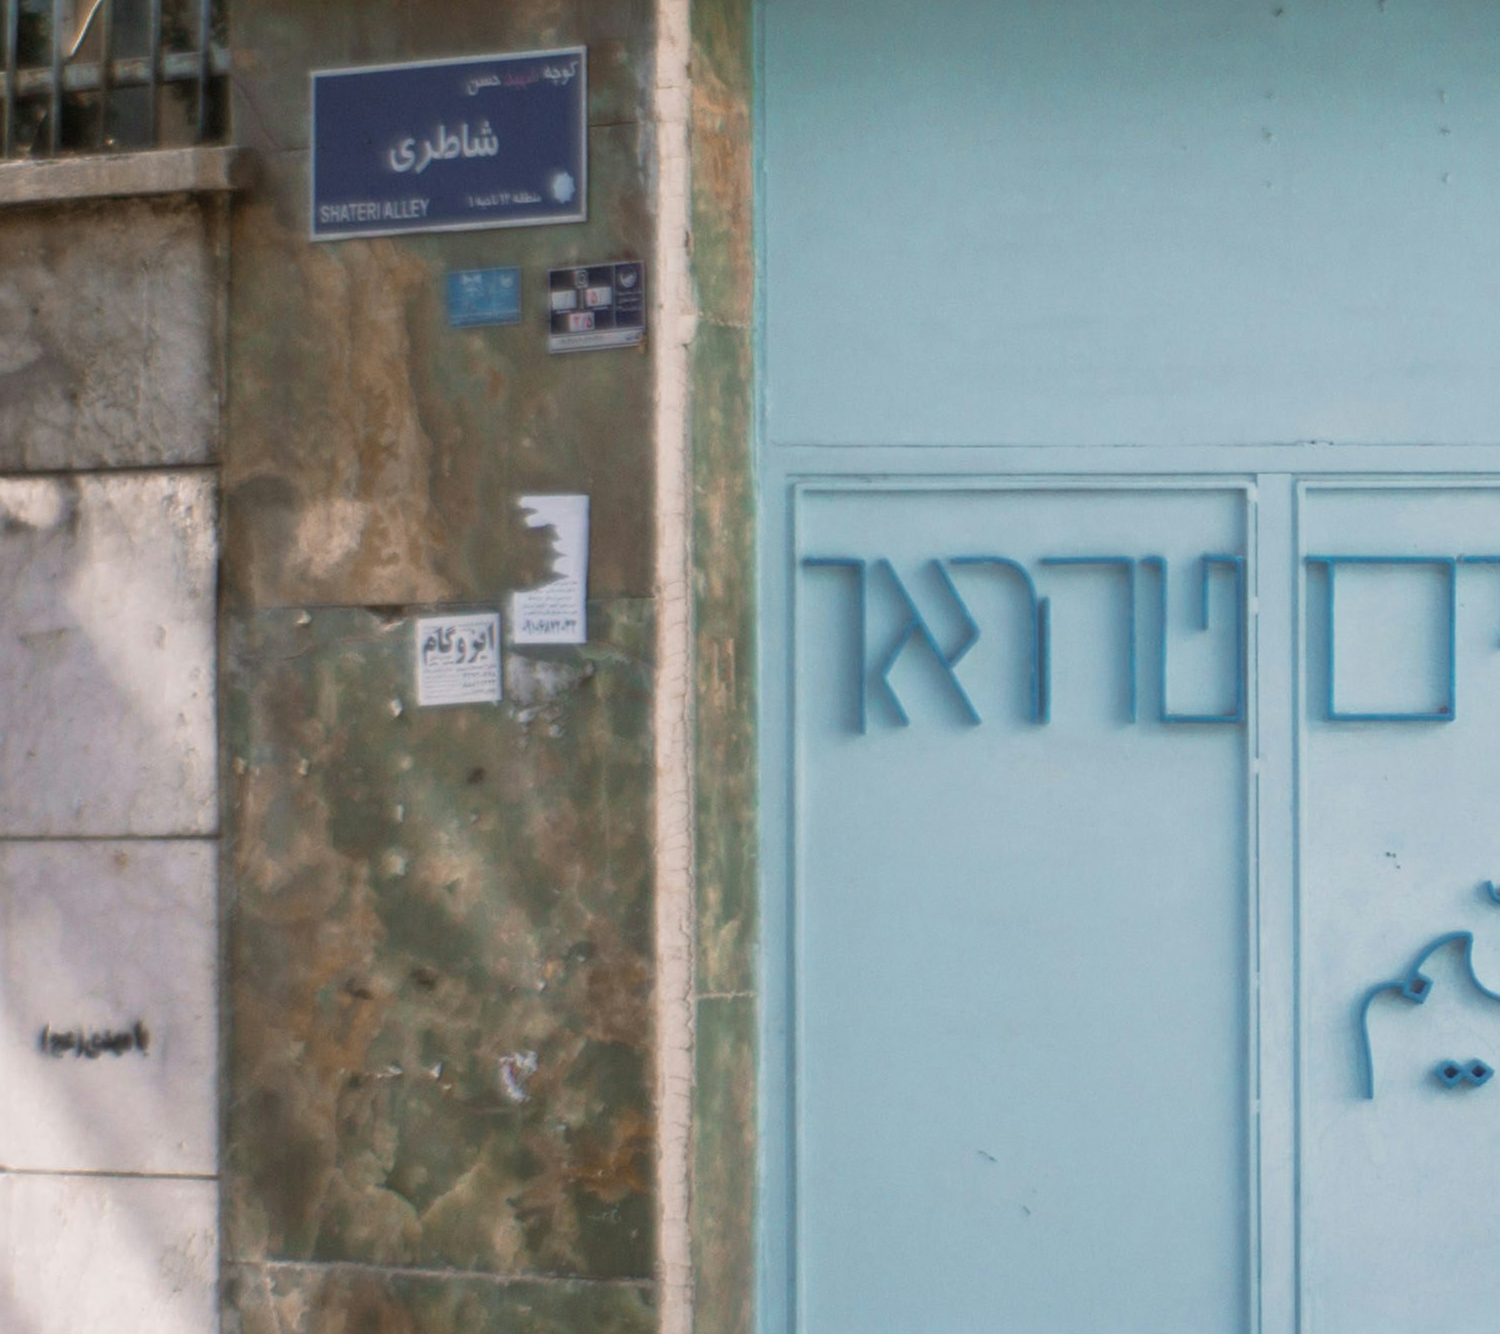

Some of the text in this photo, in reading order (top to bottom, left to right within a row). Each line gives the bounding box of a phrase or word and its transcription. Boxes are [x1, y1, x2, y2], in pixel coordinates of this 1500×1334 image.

[543, 61, 579, 85] کوچه
[467, 75, 501, 96] حسن
[389, 120, 499, 173] شاطری
[320, 199, 430, 223] SHATERI ALLEY
[423, 621, 495, 666] ایزوگام
